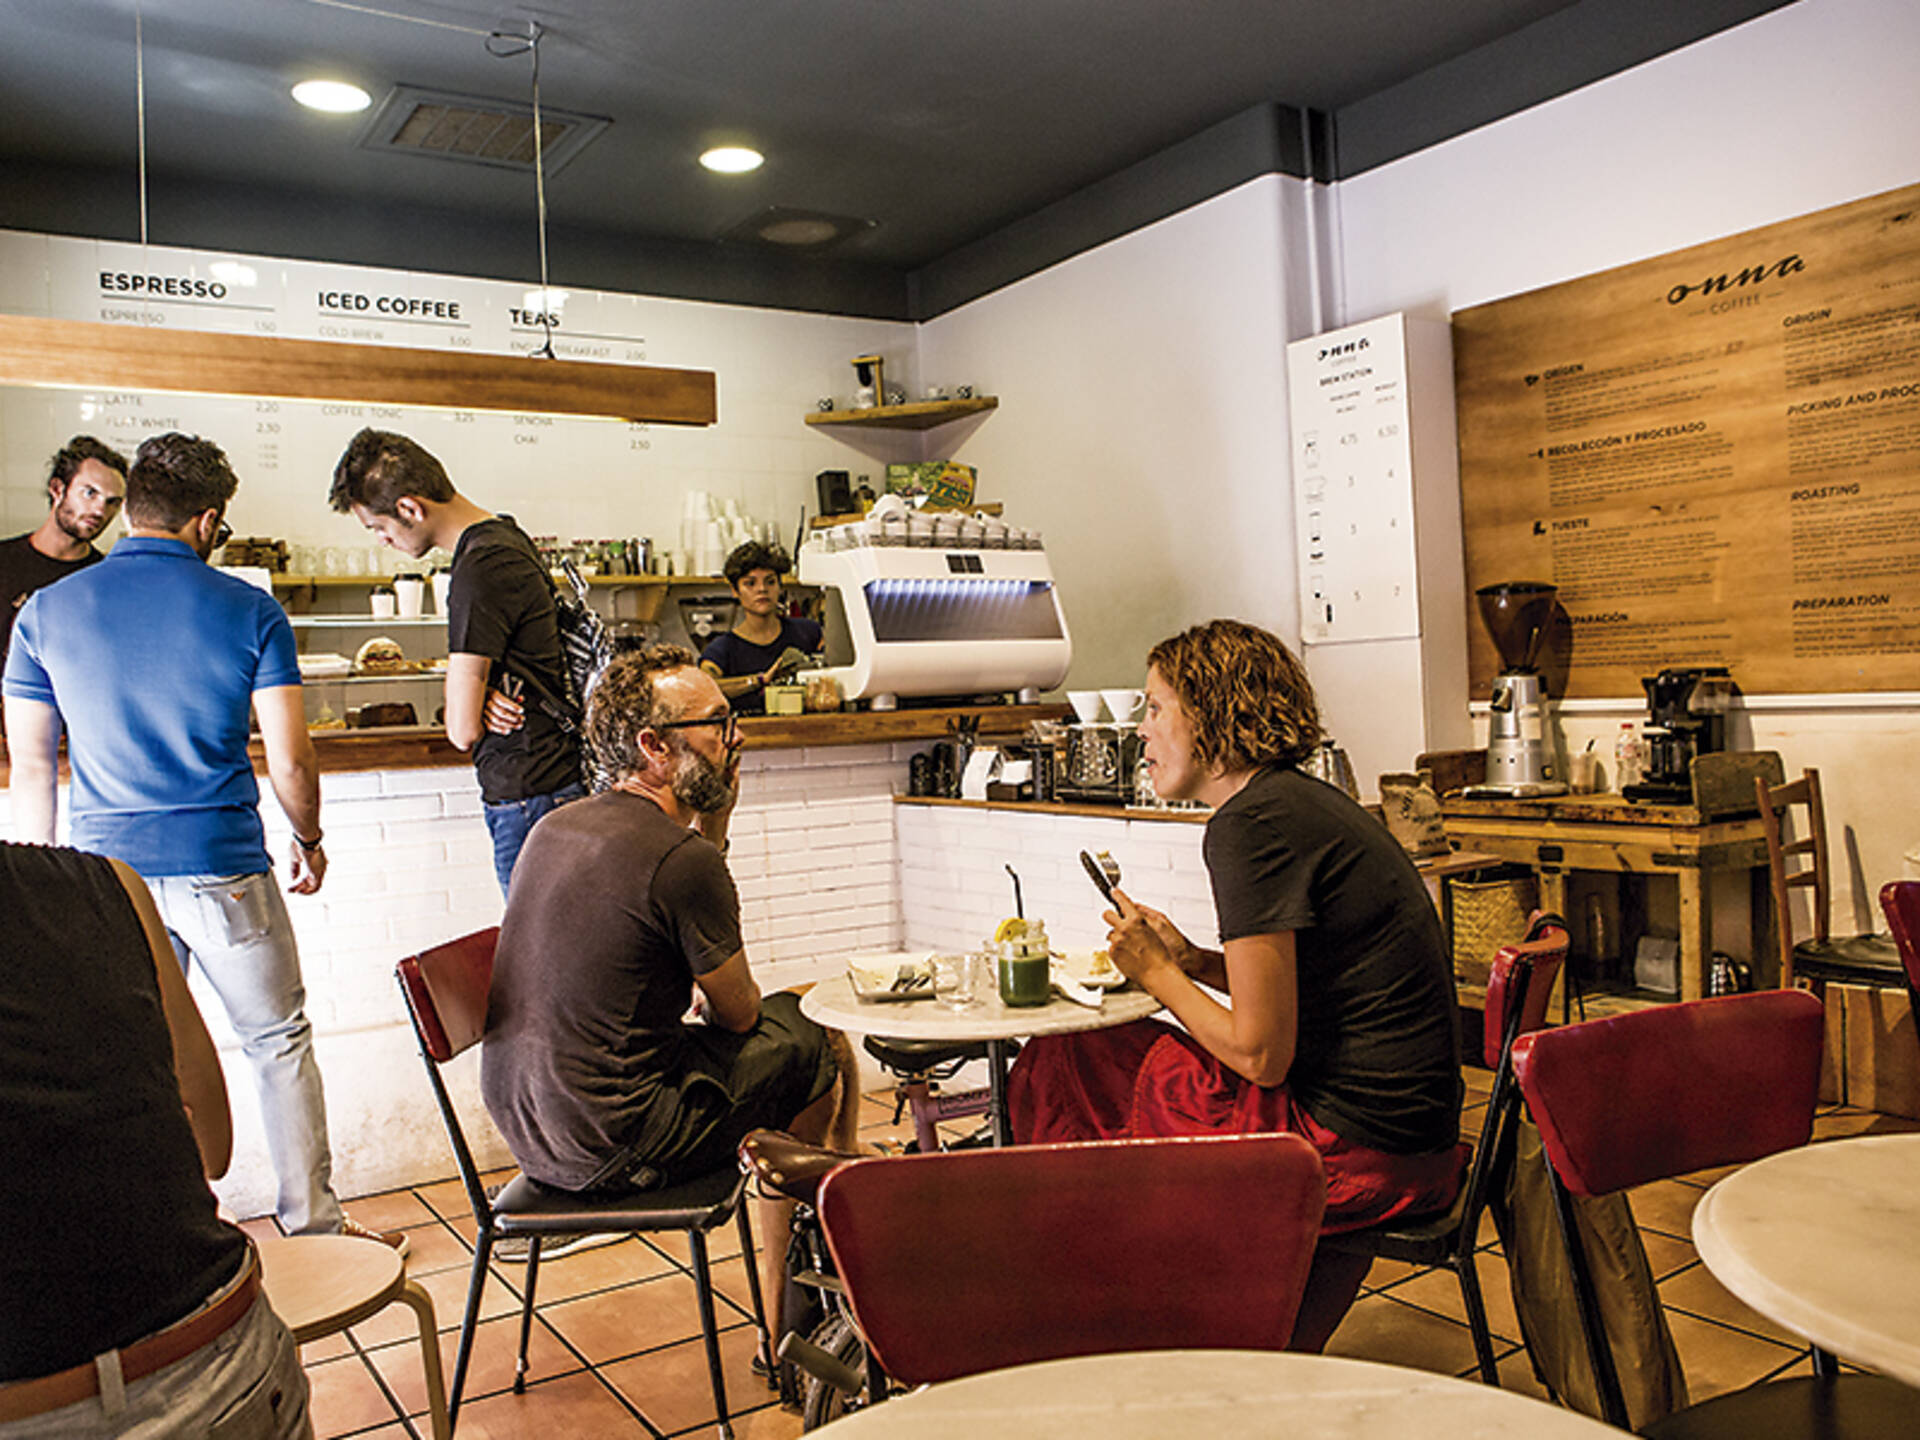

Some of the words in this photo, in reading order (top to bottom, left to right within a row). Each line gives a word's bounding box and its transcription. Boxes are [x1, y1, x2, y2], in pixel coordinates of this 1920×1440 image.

[100, 272, 227, 299] ESPRESSO
[1667, 254, 1806, 304] onna
[318, 291, 370, 311] ICED
[376, 297, 460, 319] COFFEE
[1710, 293, 1761, 315] COFFEE
[100, 309, 165, 324] ESPRESSO
[509, 308, 560, 328] TEAS
[1783, 308, 1832, 328] ORIGIN
[318, 325, 348, 338] COLD
[1544, 364, 1584, 380] ORIGEN
[105, 394, 143, 407] LATTE
[1787, 397, 1842, 416] PICKING
[1845, 391, 1877, 407] AND
[322, 405, 363, 417] COFFEE
[371, 406, 403, 419] TONIC
[141, 417, 180, 430] WHITE
[1548, 436, 1622, 456] RECOLECCIÓN
[1625, 434, 1632, 444] Y
[1635, 421, 1707, 442] PROCESADO
[1791, 482, 1861, 501] ROASTING
[1552, 518, 1590, 531] TUESTE
[1792, 593, 1891, 611] PREPARATION
